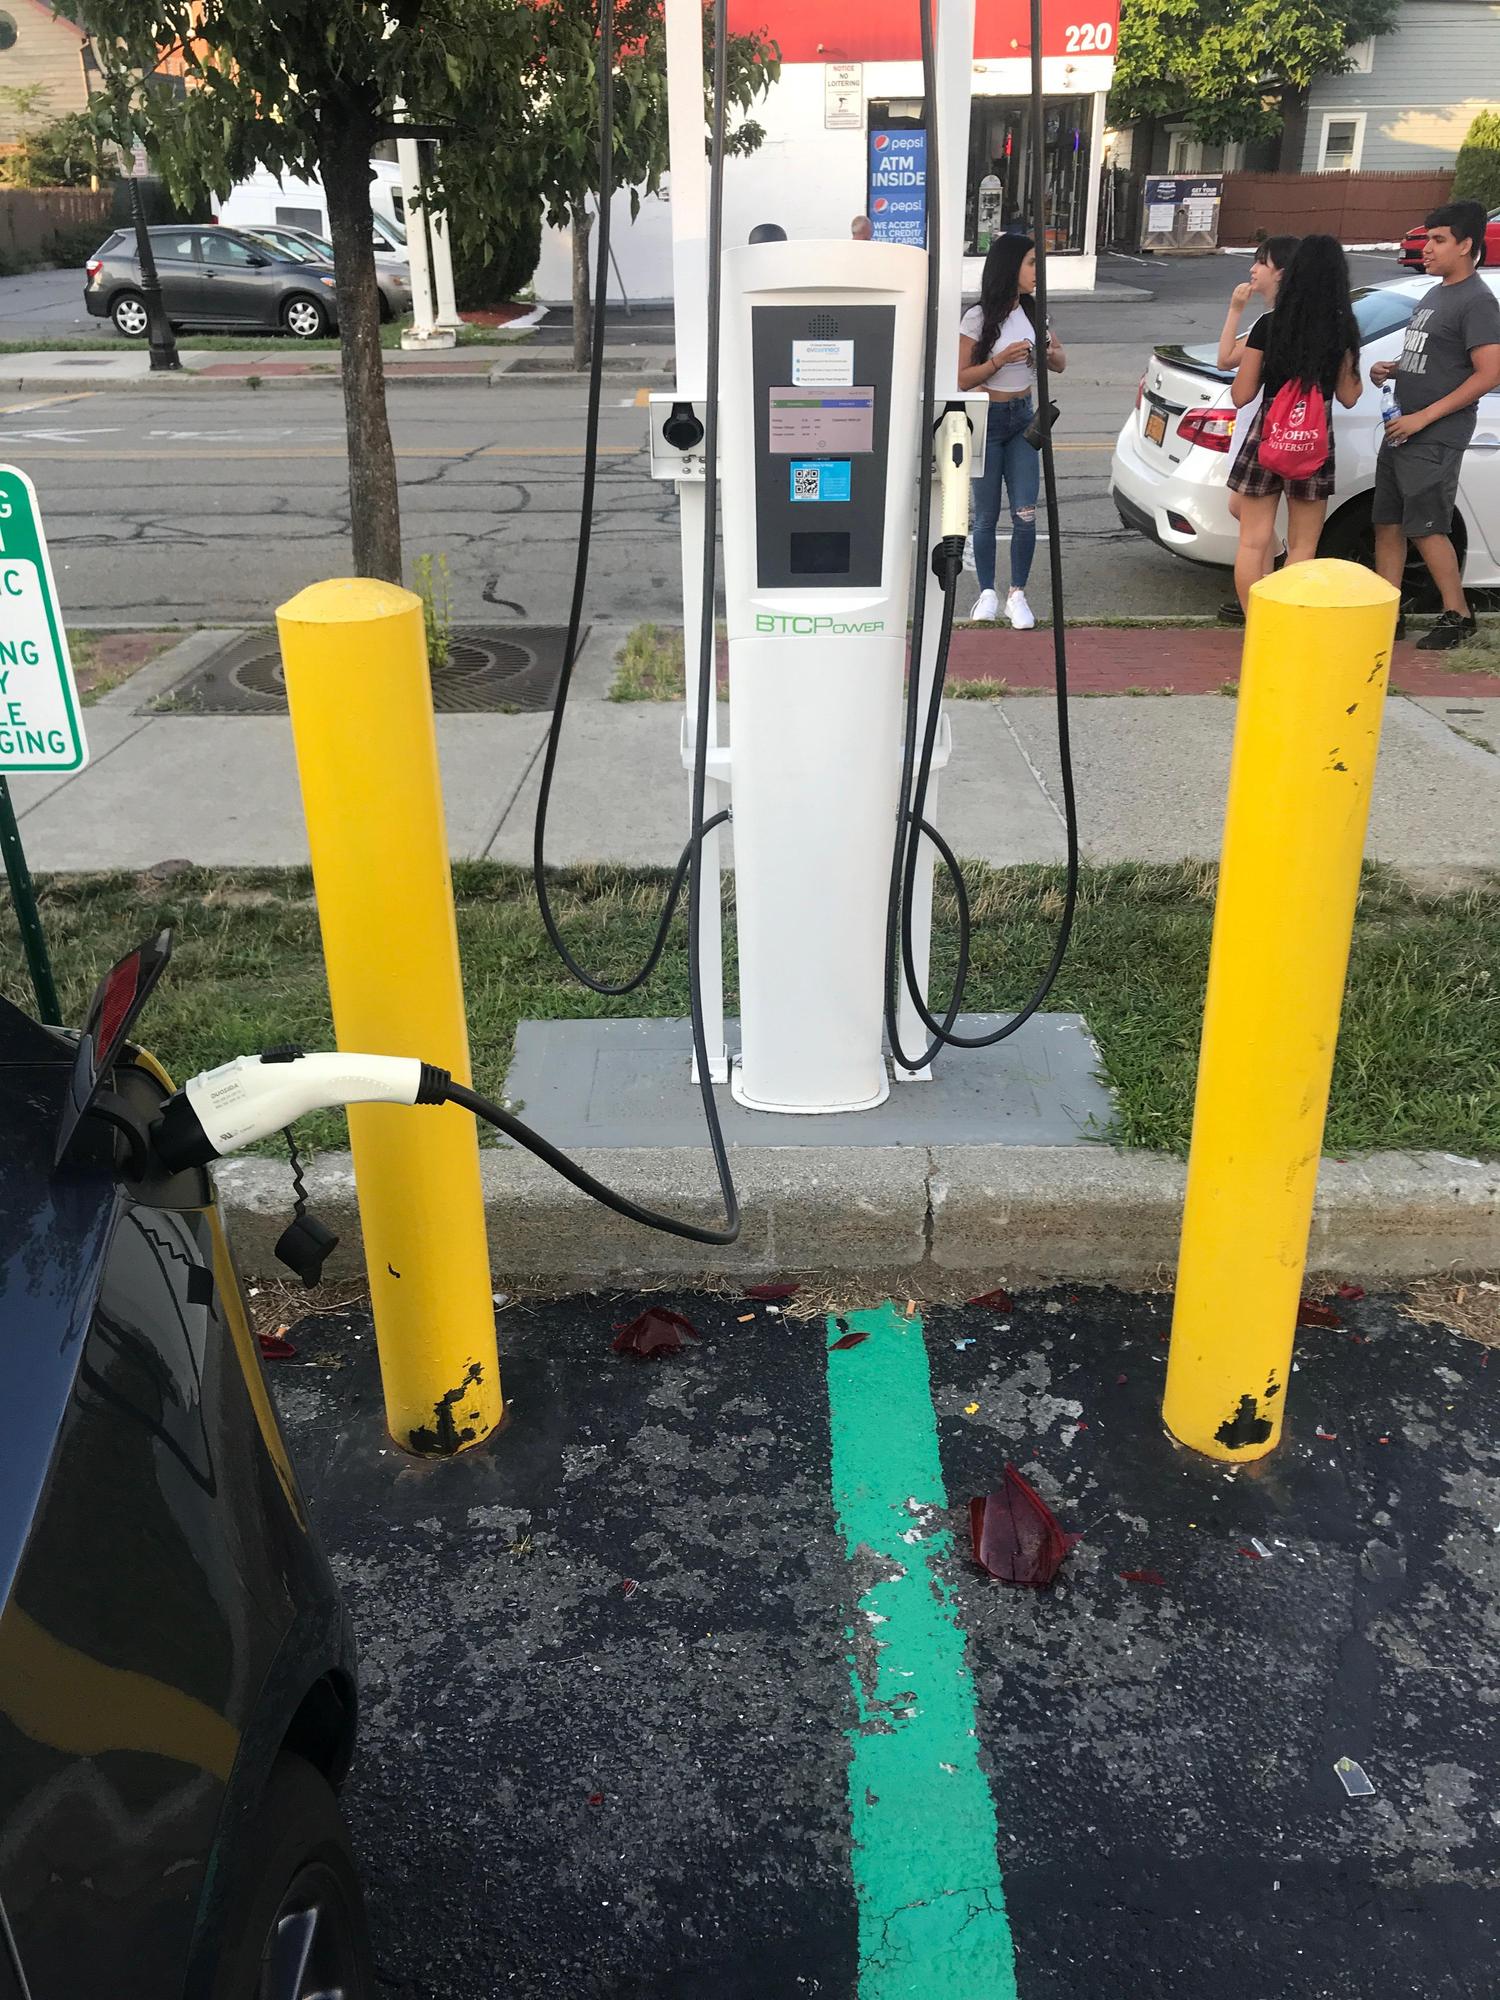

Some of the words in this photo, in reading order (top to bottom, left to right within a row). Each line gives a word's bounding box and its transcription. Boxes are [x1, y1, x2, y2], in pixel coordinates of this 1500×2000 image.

[1065, 22, 1112, 52] 220
[891, 136, 924, 150] pepsi
[879, 156, 914, 171] ATM
[872, 172, 926, 187] INSIDE
[890, 199, 922, 213] pepsi
[873, 221, 888, 229] WE
[888, 221, 920, 229] ACCEPT
[889, 229, 922, 238] CREDIT/
[0, 569, 23, 596] C
